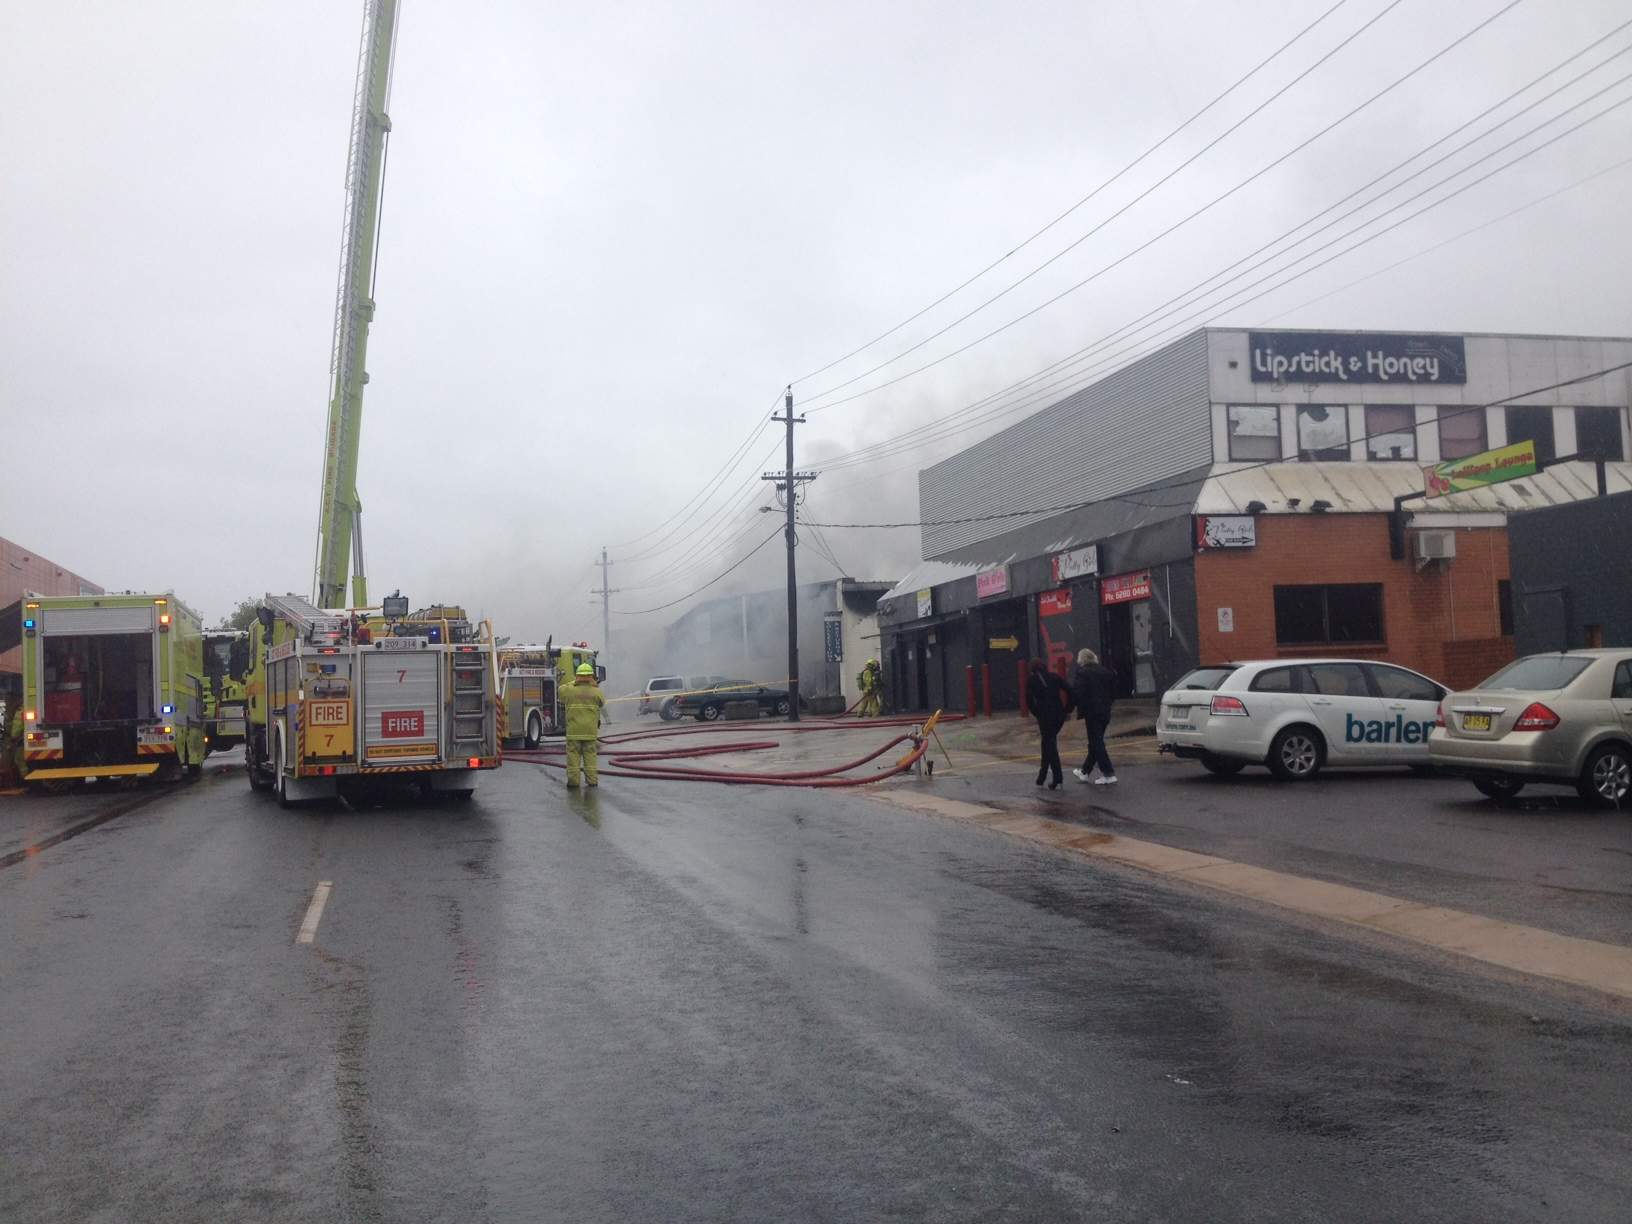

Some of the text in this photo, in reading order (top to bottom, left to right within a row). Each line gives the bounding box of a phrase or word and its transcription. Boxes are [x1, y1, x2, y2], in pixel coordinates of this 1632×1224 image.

[1255, 349, 1439, 380] Lipstick & Honey
[397, 669, 407, 683] 7
[315, 706, 343, 721] FIRE
[388, 717, 418, 732] FIRE
[324, 734, 334, 747] 7
